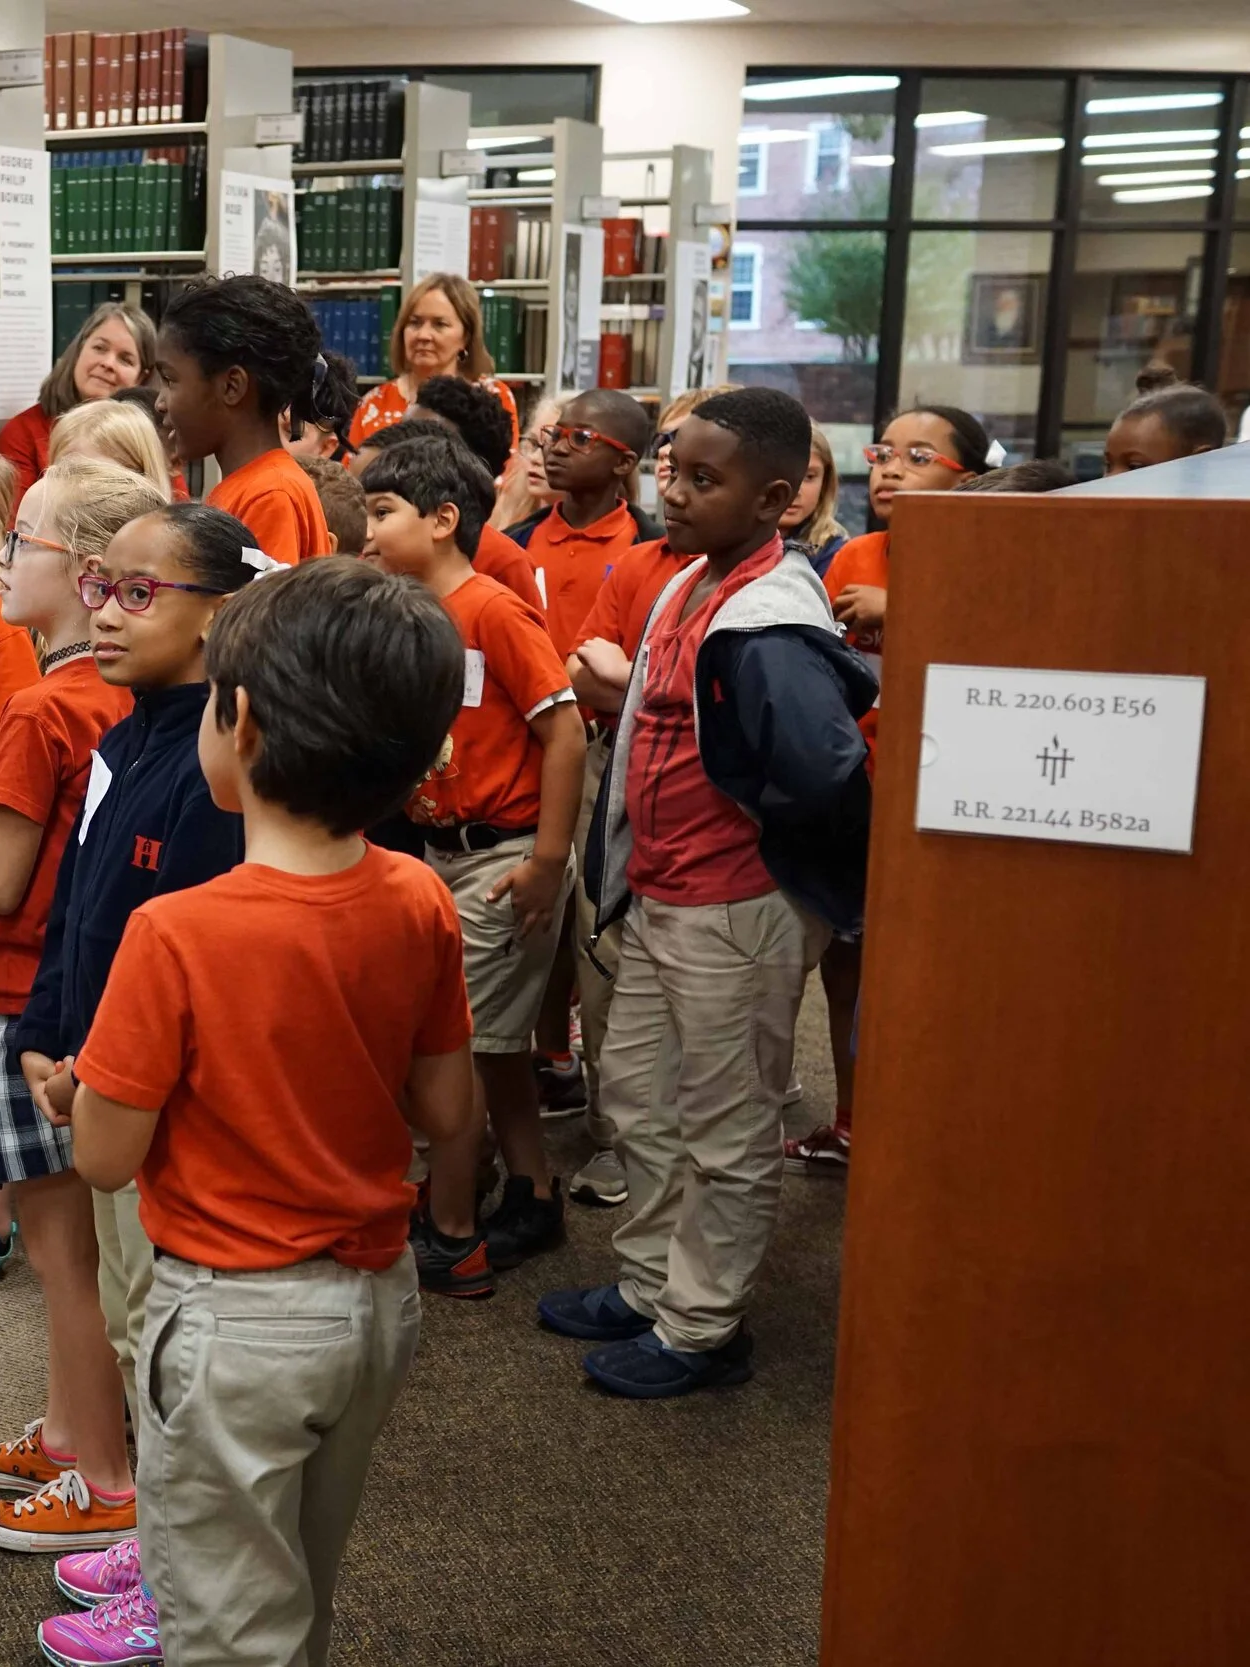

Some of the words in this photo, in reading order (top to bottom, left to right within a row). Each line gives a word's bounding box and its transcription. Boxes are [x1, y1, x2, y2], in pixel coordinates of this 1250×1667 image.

[0, 155, 33, 170] GEORGE
[0, 173, 27, 187] PHILIP
[0, 191, 34, 205] BOWSER
[965, 687, 1008, 707] R.R.
[1015, 692, 1106, 717] 220.603
[1111, 696, 1156, 718] E56
[952, 799, 995, 820] R.R.
[1002, 805, 1073, 829] 221.44
[1079, 810, 1151, 833] B582a
[130, 835, 163, 872] H
